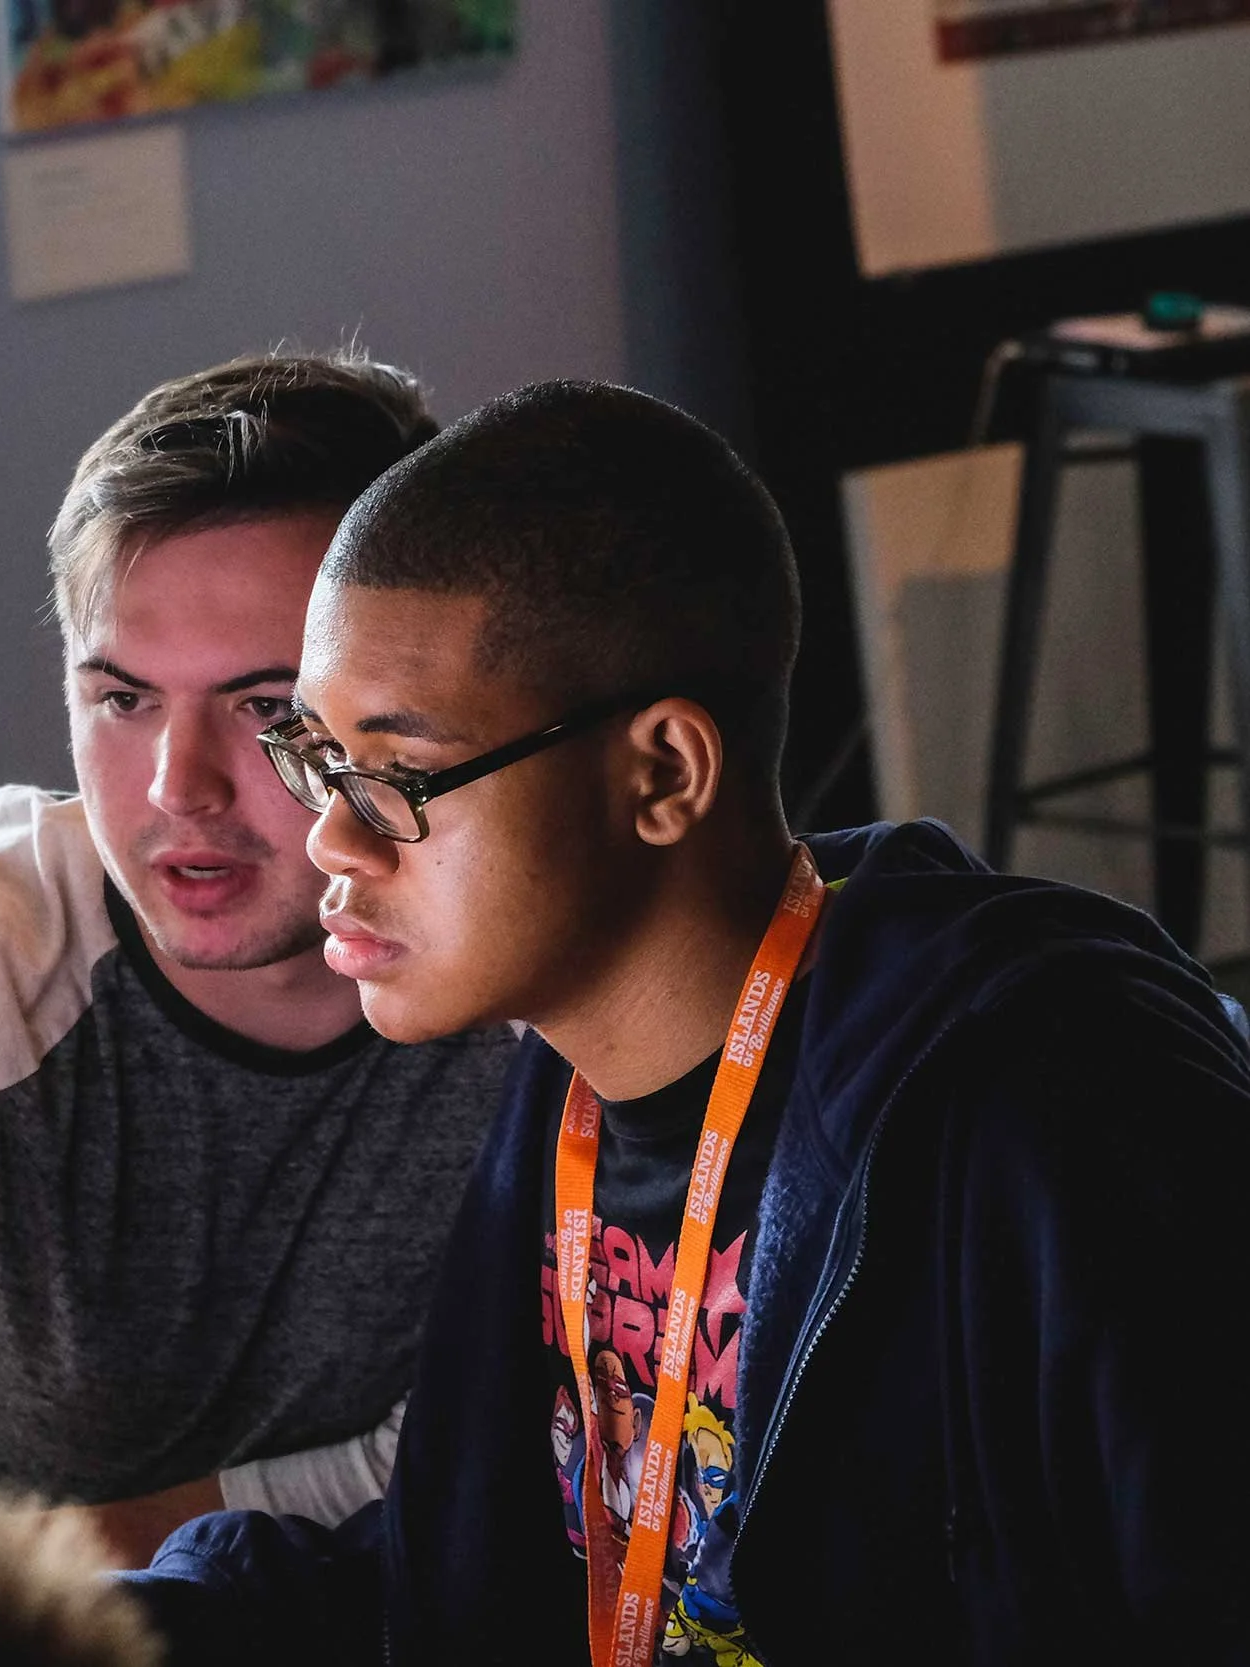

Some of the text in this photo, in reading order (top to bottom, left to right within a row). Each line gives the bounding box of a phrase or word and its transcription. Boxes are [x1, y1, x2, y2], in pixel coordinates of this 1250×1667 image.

[726, 969, 770, 1065] ISLANDS
[748, 978, 785, 1050] Brilliance
[688, 1130, 718, 1221] ISLANDS
[704, 1138, 729, 1208] Brilliance
[571, 1208, 588, 1302] ISLANDS
[663, 1288, 686, 1379] ISLANDS
[637, 1440, 662, 1529] ISLANDS
[653, 1449, 672, 1517] Brilliance
[615, 1592, 640, 1667] SLANDS
[634, 1597, 654, 1661] Brilliance
